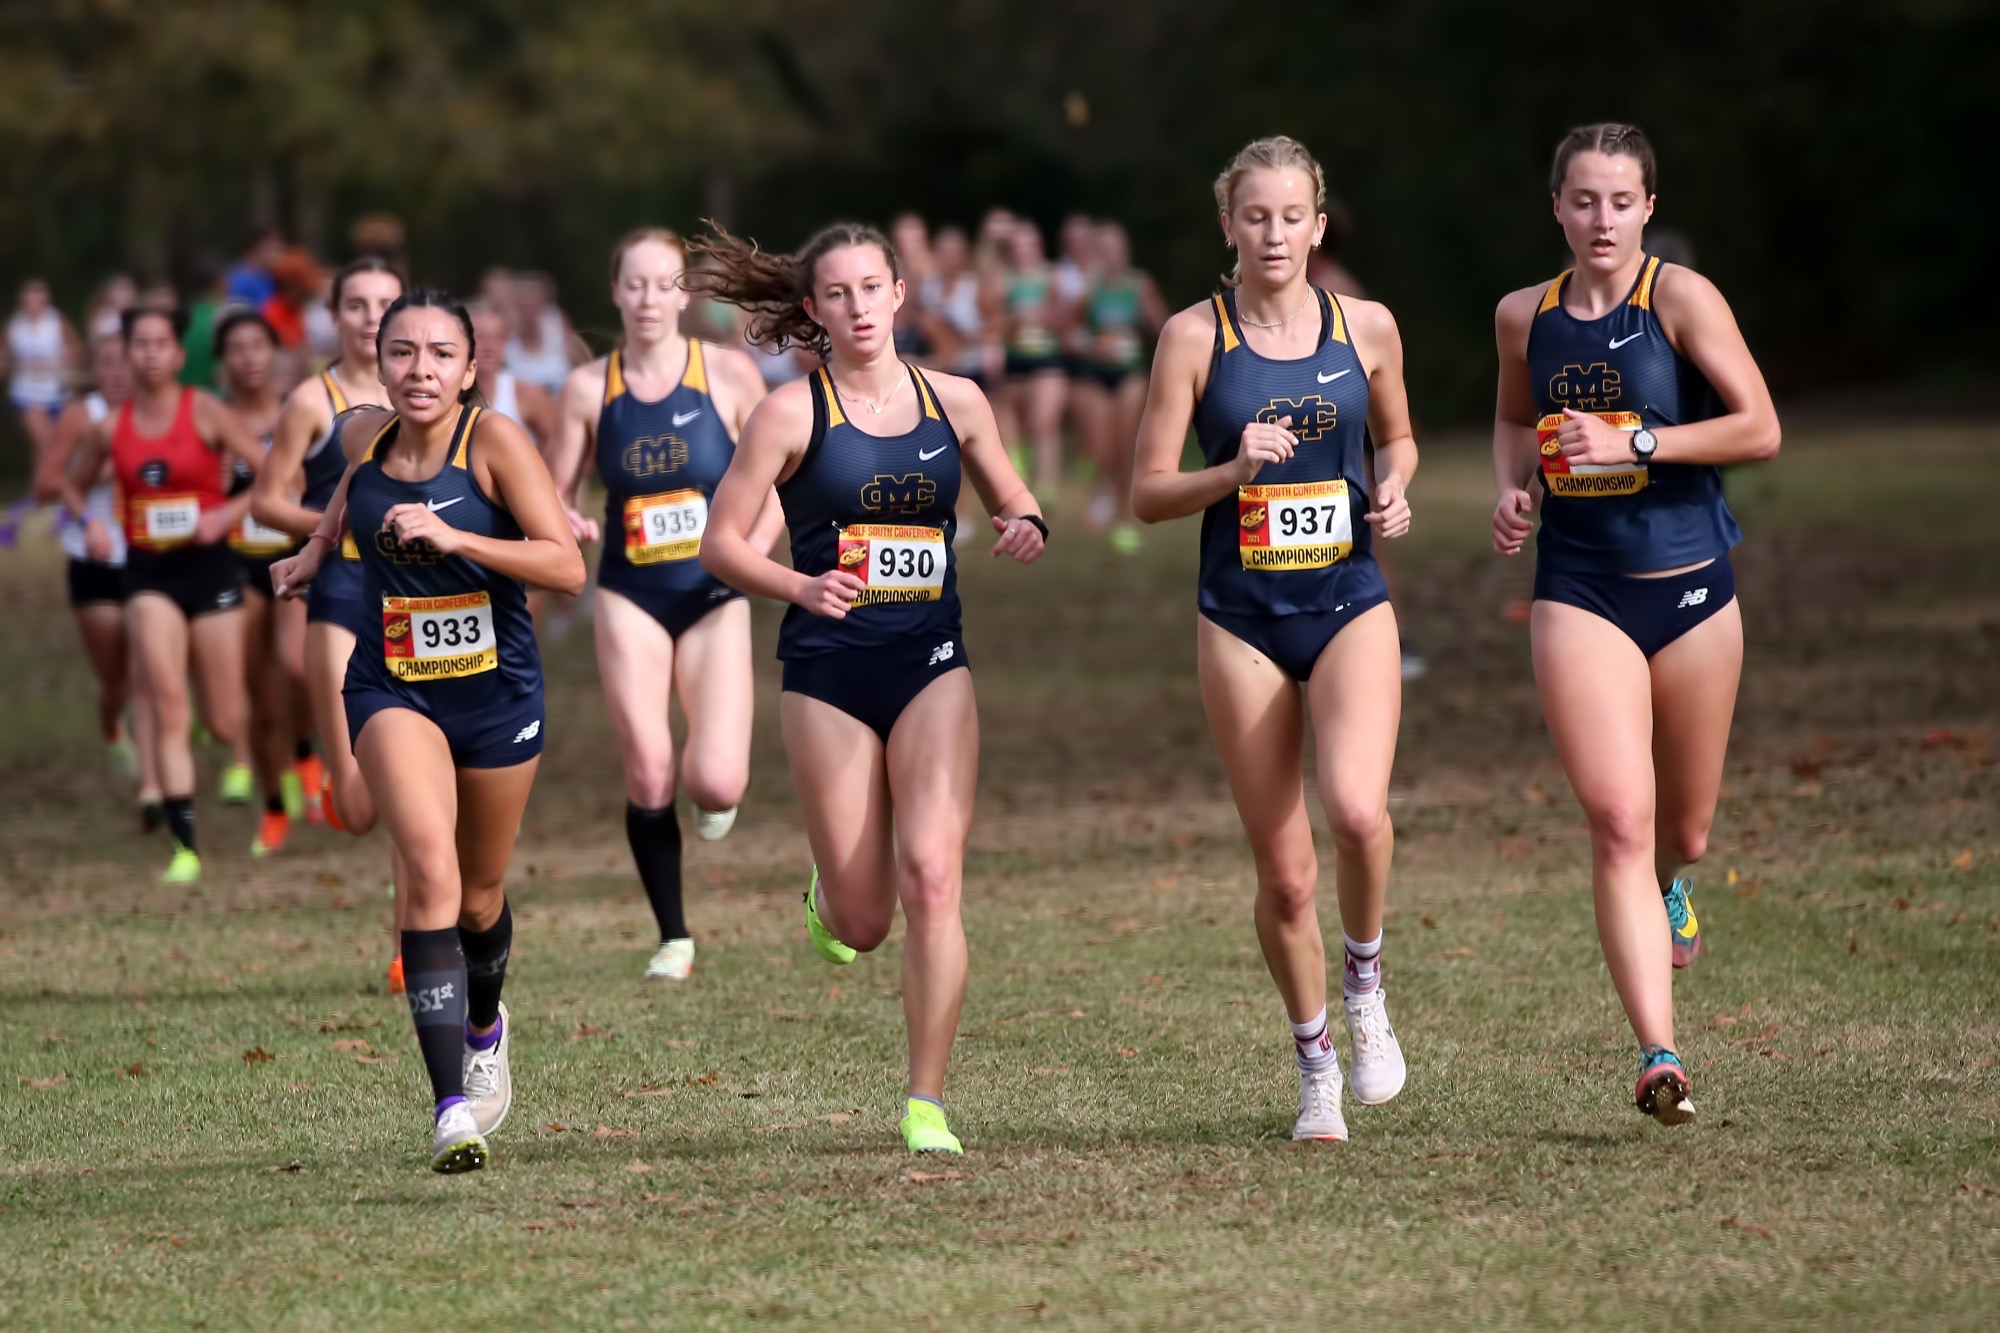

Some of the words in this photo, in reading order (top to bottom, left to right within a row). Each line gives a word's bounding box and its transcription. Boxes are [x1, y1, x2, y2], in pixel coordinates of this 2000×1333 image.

[1544, 415, 1561, 427] GULF
[1247, 486, 1263, 498] GULF
[1266, 485, 1291, 498] SOUTH
[1293, 482, 1340, 497] CONFERENCE
[1556, 474, 1636, 492] CHAMPIONSHIP
[653, 508, 697, 537] 935
[1280, 504, 1336, 537] 937
[847, 525, 866, 537] GULF
[868, 526, 892, 538] SOUTH
[894, 526, 937, 540] CONFERENCE
[1247, 534, 1260, 543] 2021
[879, 547, 935, 578] 930
[1252, 546, 1340, 566] CHAMPIONSHIP
[856, 589, 930, 604] HAMPIONSHIP
[422, 615, 481, 648] 933
[398, 654, 484, 677] CHAMPIONSHIP
